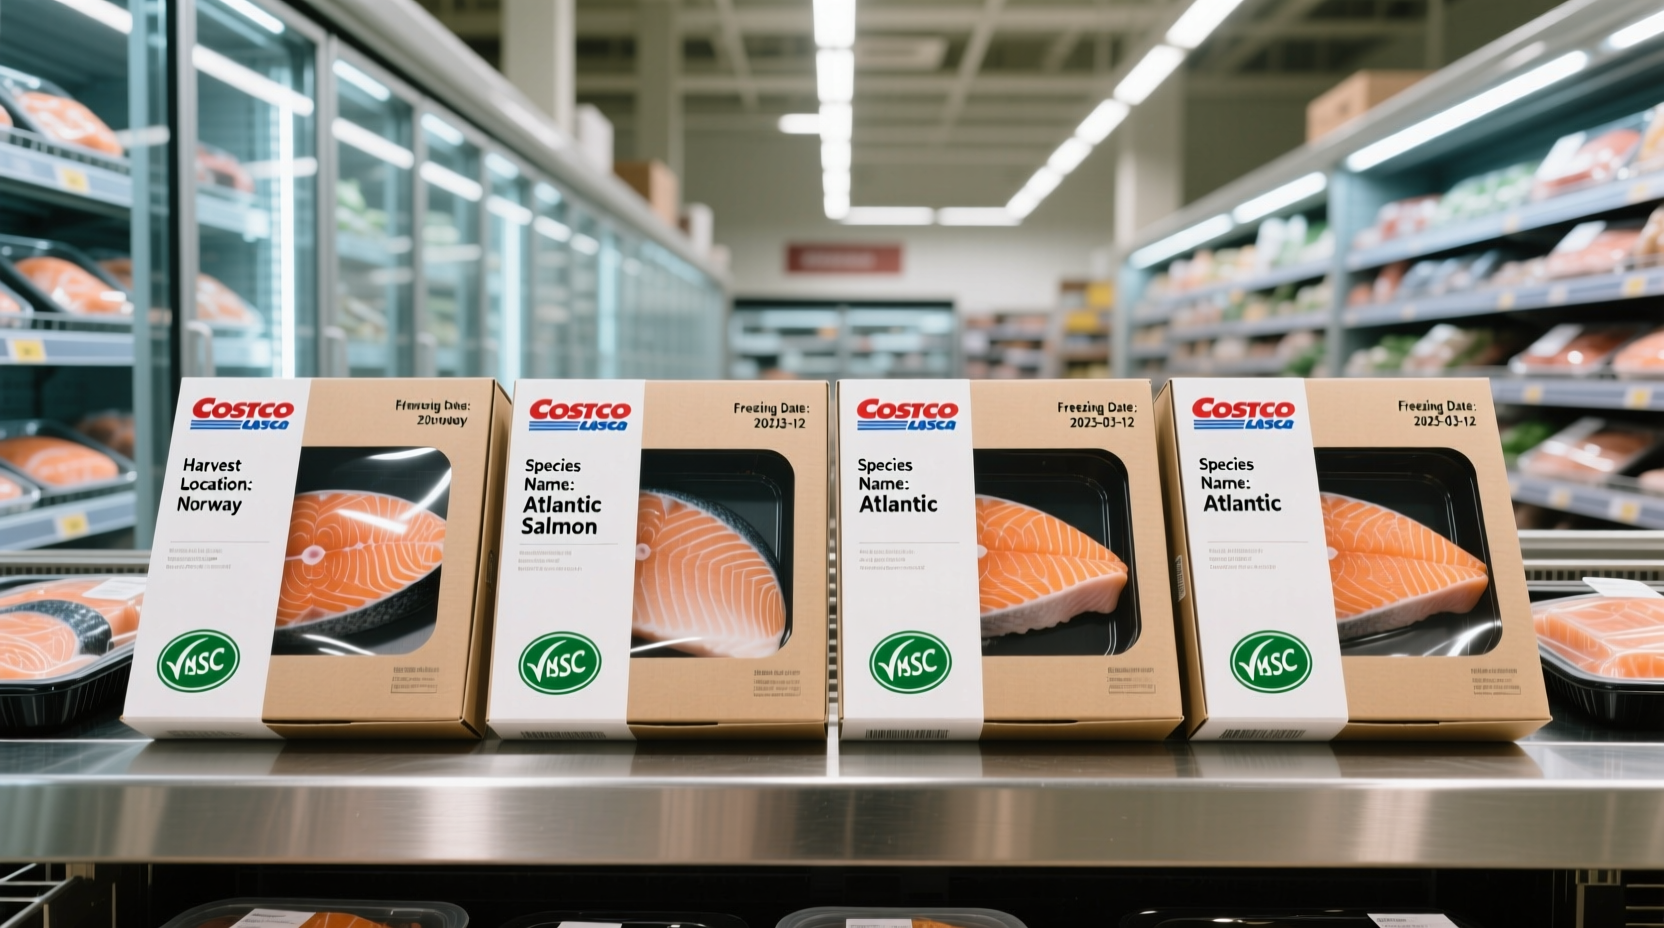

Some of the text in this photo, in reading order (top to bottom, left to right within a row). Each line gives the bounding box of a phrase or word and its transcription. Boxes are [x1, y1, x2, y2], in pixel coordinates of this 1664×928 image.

[1057, 401, 1137, 416] Freezing Date:
[1447, 400, 1477, 412] Date:
[183, 457, 243, 472] Harvest
[524, 457, 582, 474] Species
[857, 457, 913, 475] Species
[1199, 456, 1255, 474] Species
[180, 476, 253, 491] Location:
[524, 476, 575, 491] Name:
[858, 476, 910, 491] Name:
[1201, 475, 1252, 490] Name:
[176, 495, 243, 516] Norway
[522, 494, 602, 513] Atlantic
[858, 493, 938, 513] Atlantic
[1203, 492, 1283, 512] Atlantic
[520, 516, 598, 535] Salmon
